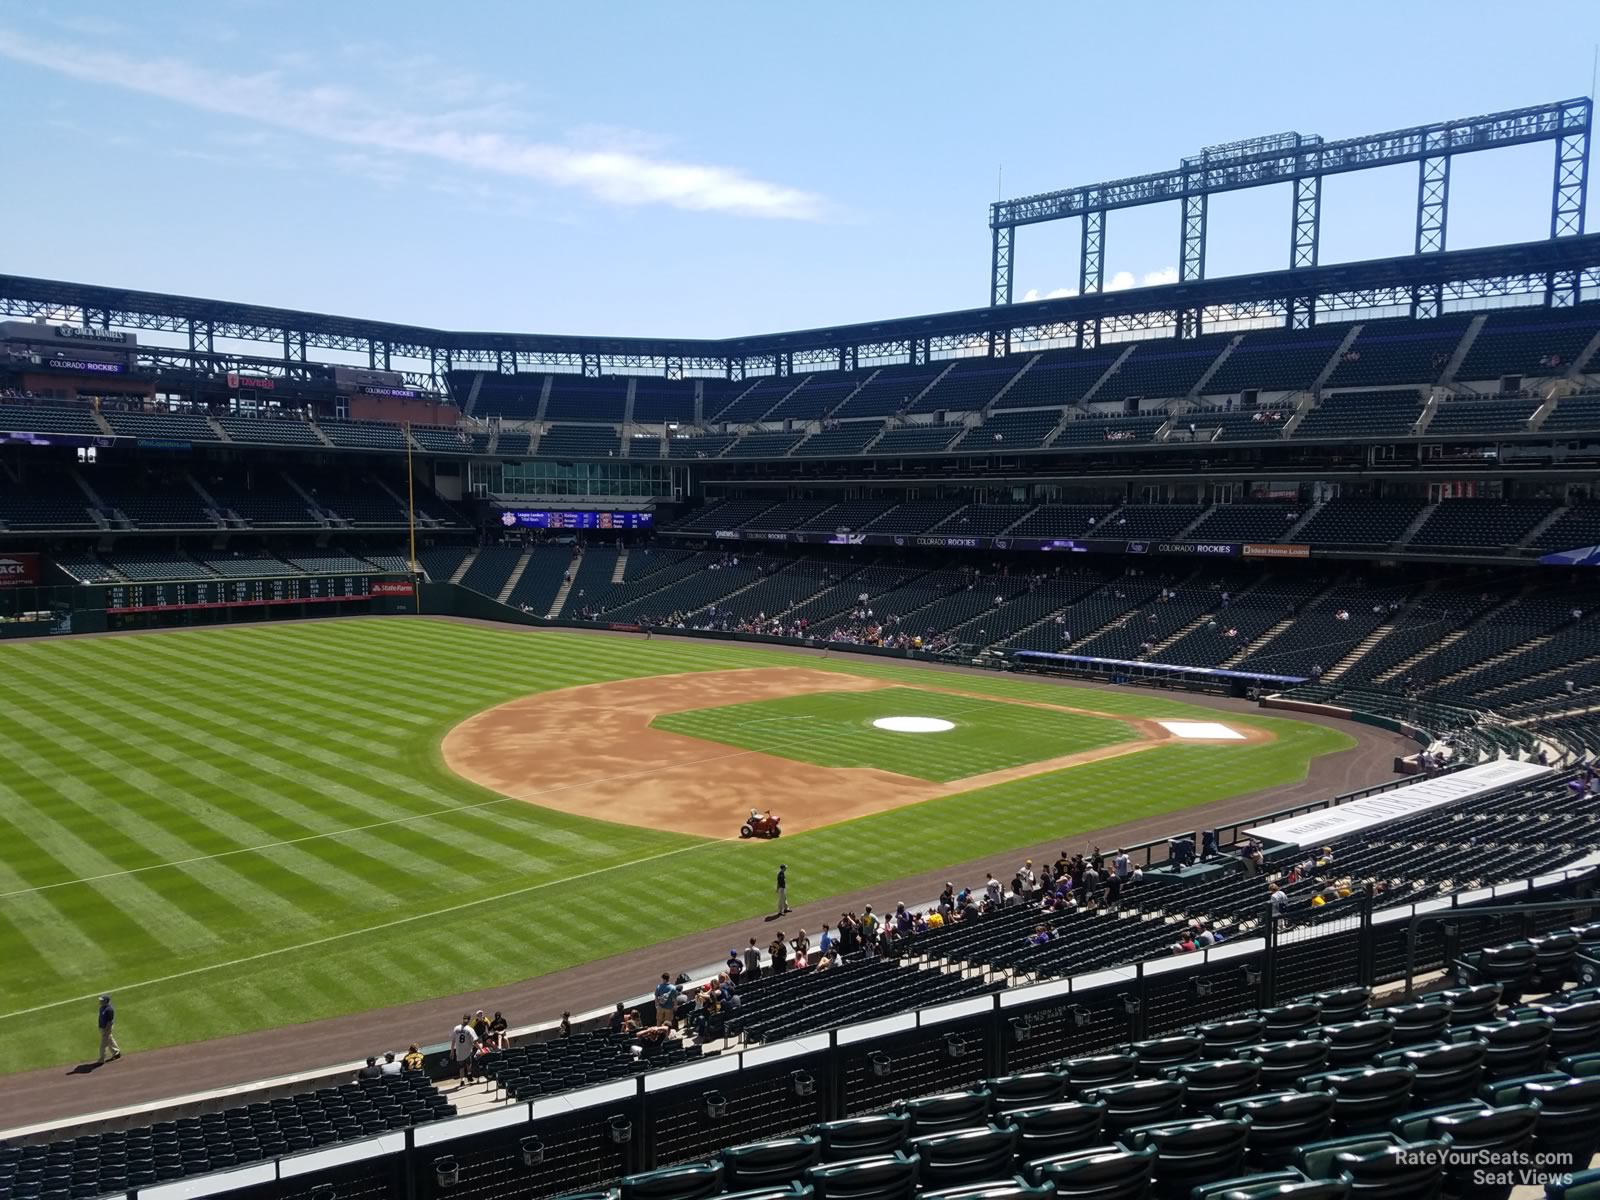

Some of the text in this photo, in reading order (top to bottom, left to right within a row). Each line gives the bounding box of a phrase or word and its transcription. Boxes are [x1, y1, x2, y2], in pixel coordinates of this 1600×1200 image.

[50, 360, 118, 372] COLORADO ROCKIES
[1158, 544, 1231, 553] COLORADO ROCKIES
[1340, 778, 1486, 818] COORS FIELD
[460, 1034, 465, 1043] 8
[408, 1058, 422, 1069] 22
